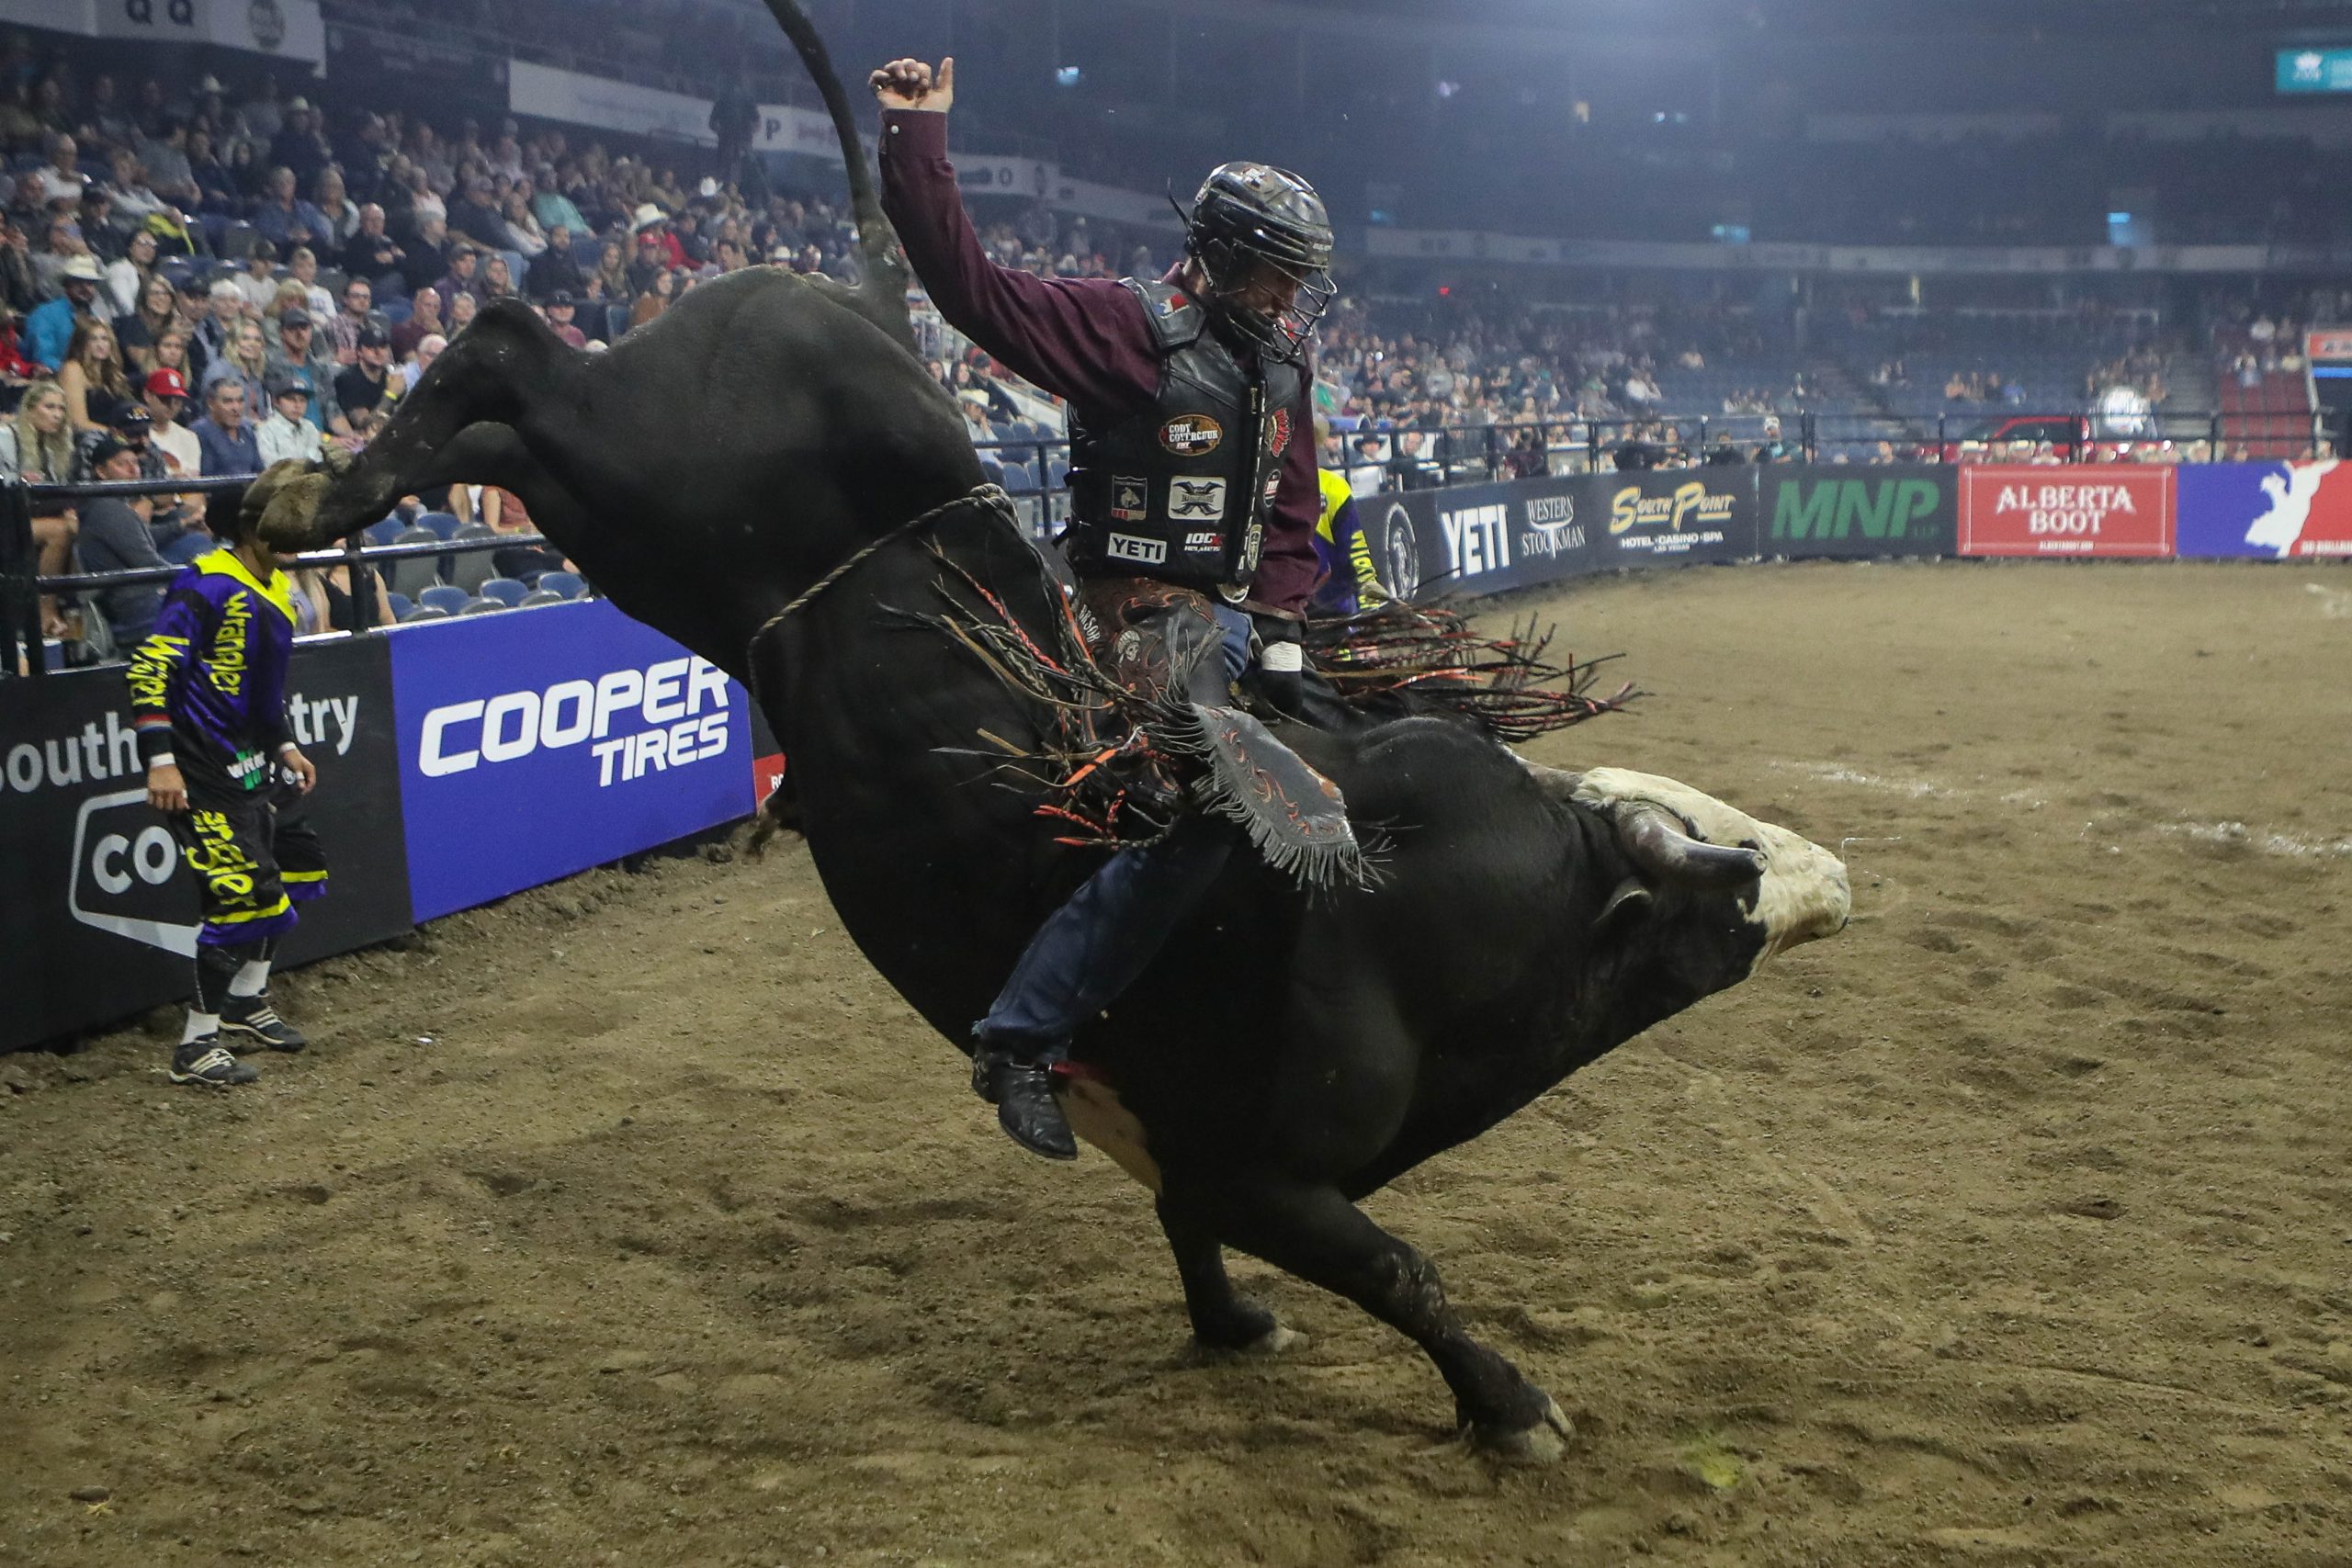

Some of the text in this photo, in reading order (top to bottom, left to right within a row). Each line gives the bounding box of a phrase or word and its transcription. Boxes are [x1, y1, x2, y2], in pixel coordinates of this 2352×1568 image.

[1527, 496, 1574, 521] WESTERN
[1771, 479, 1940, 540] MNP
[1996, 485, 2136, 514] ALBERTA
[2030, 509, 2107, 535] BOOT
[1113, 536, 1162, 559] YETI
[1441, 503, 1510, 580] YETI
[1522, 525, 1586, 557] STOCKMAN
[200, 591, 254, 696] Wrangler
[419, 656, 729, 778] COOPER
[0, 710, 143, 793] outh
[592, 712, 729, 787] TIRES
